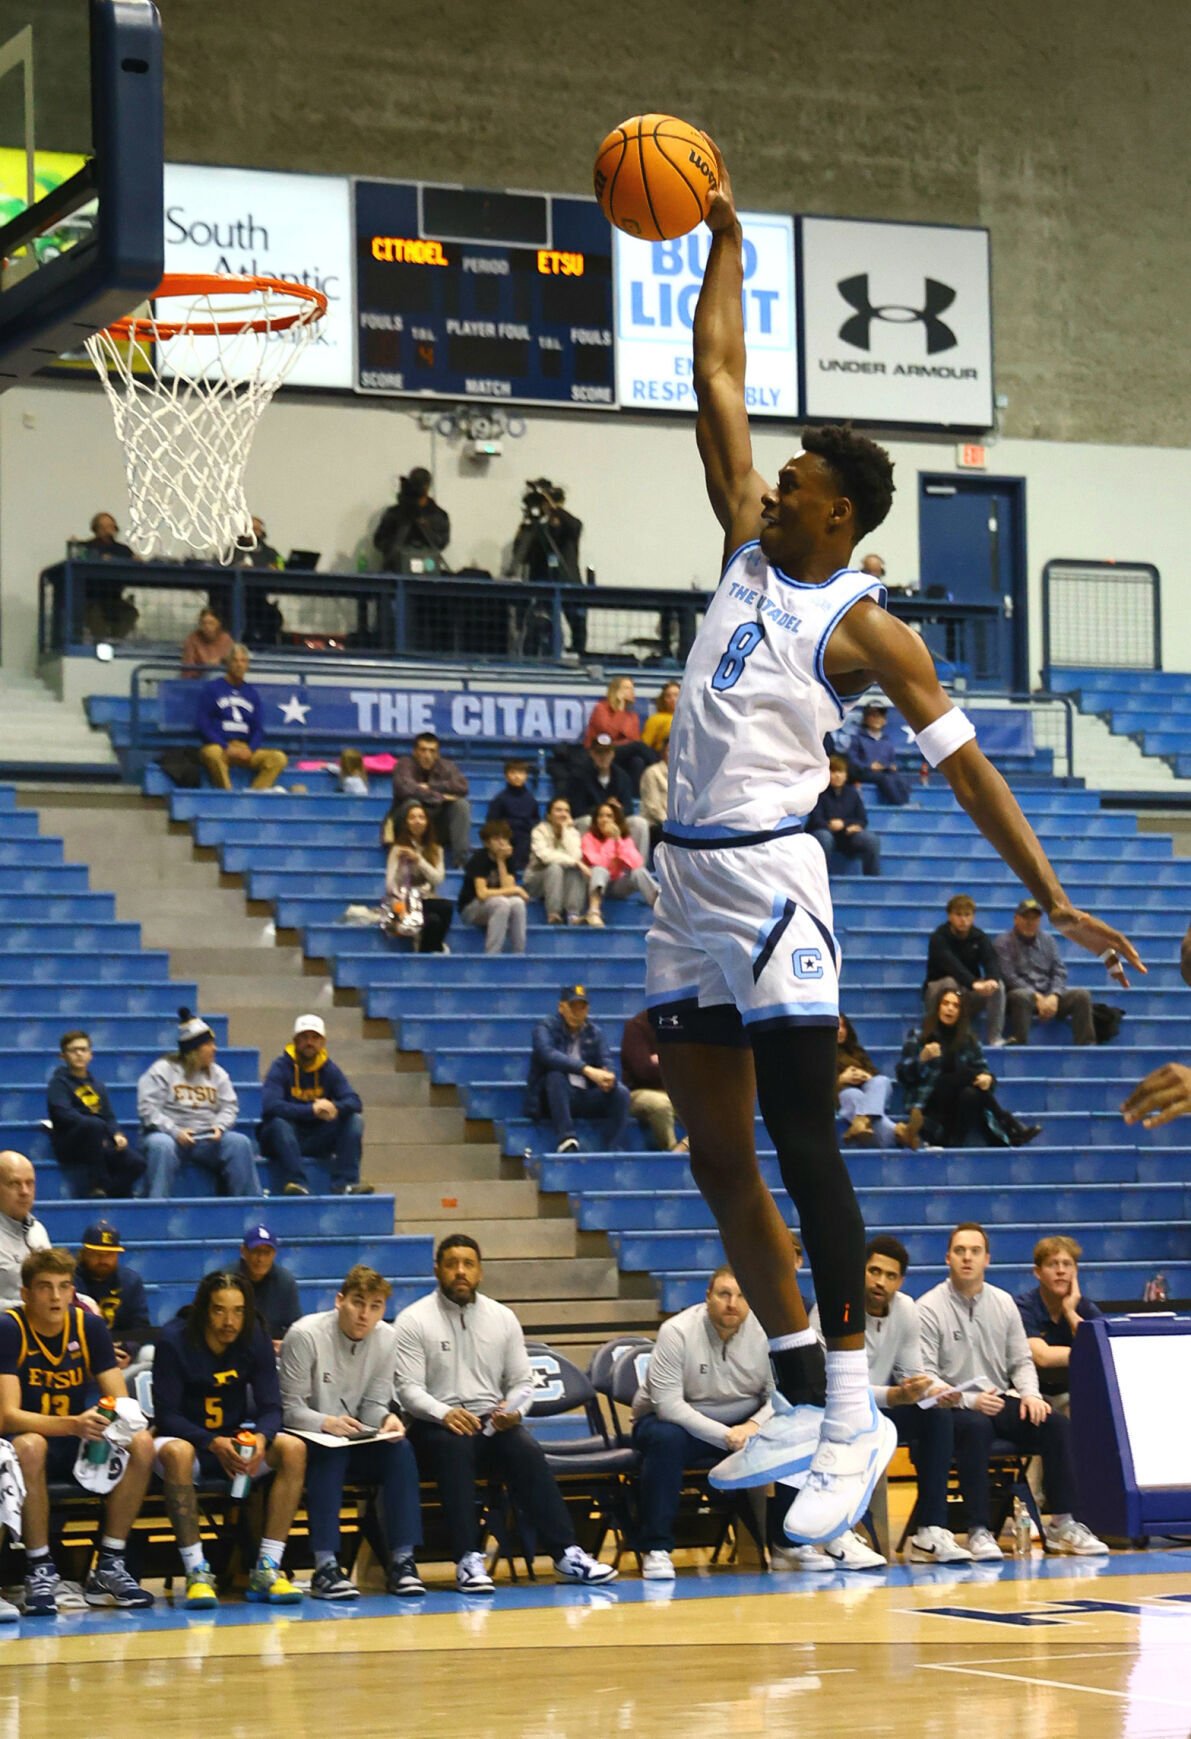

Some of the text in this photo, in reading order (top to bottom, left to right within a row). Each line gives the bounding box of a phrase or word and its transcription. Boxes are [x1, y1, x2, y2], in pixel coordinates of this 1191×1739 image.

[166, 206, 269, 251] South
[462, 256, 510, 275] PERIOD
[537, 250, 584, 276] ETSU
[630, 281, 779, 334] LIGT
[360, 312, 403, 331] FOULS
[446, 319, 531, 341] PLAYER FOUL
[570, 327, 612, 347] FOULS
[360, 371, 403, 389] SCORE
[818, 359, 978, 381] UNDER ARMOUR
[465, 378, 512, 396] MATCH
[570, 384, 611, 402] SCORE
[728, 581, 758, 606] THE
[711, 620, 766, 693] 8
[350, 691, 436, 734] THE
[792, 948, 824, 980] C
[173, 1084, 217, 1105] ETSU
[441, 1341, 451, 1352] E
[28, 1367, 84, 1390] ETSU
[700, 1364, 709, 1374] E
[205, 1397, 224, 1430] 5
